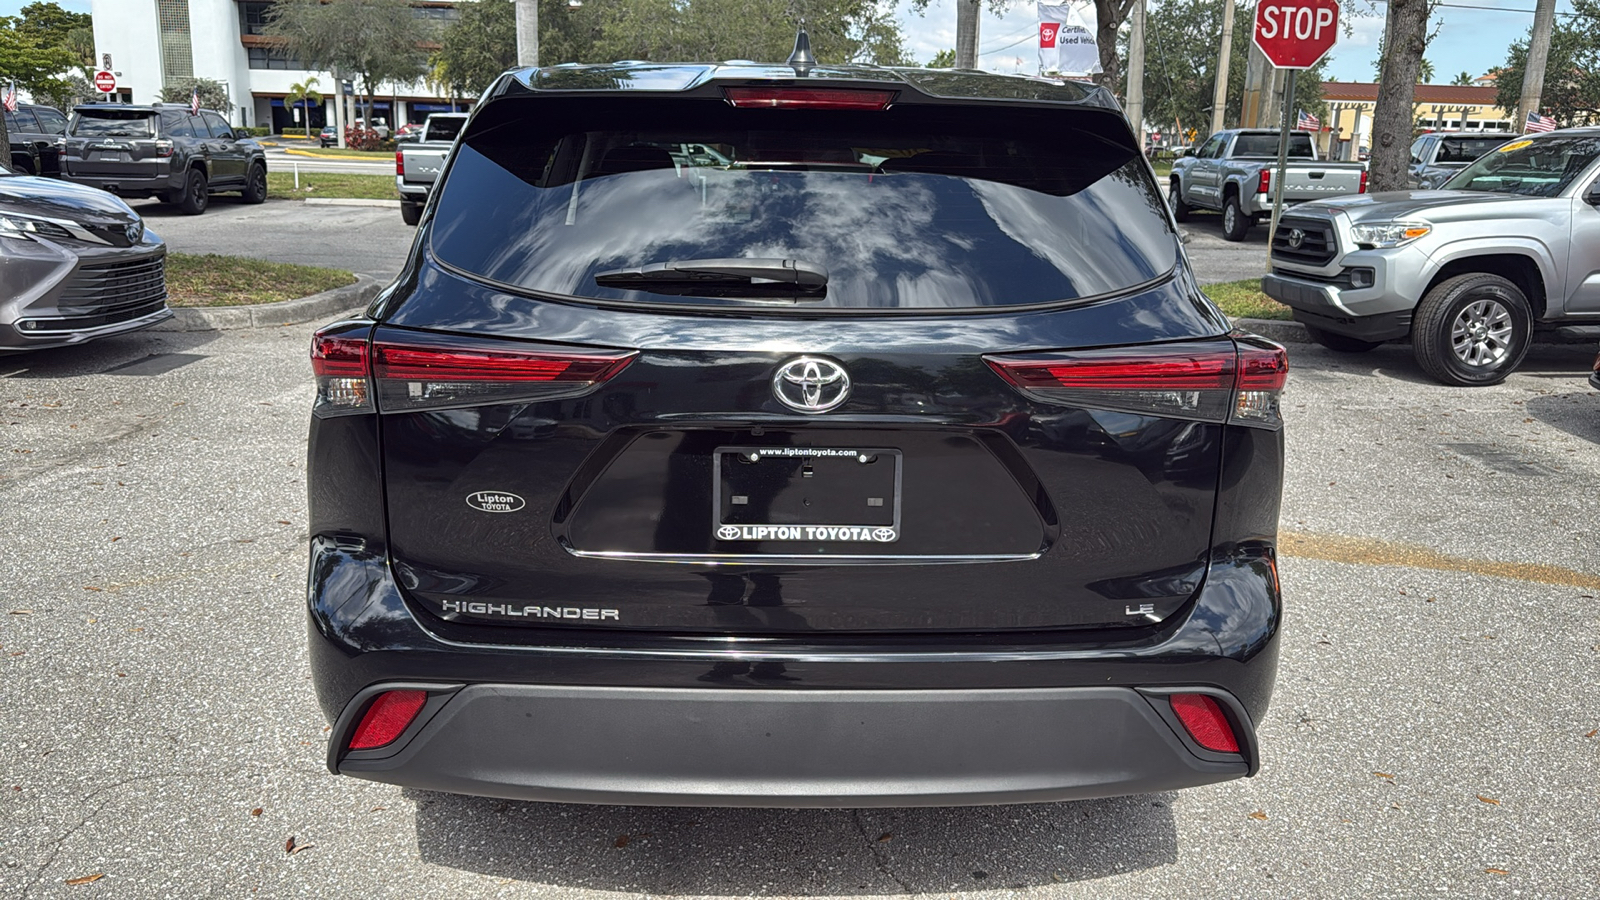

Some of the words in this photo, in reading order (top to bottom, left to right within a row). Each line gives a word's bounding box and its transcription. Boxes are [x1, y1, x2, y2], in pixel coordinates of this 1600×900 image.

[1261, 5, 1333, 40] STOP
[1060, 36, 1079, 45] Used
[759, 447, 857, 457] www.liptontoyota.com
[477, 493, 514, 504] Lipton
[481, 503, 511, 511] TOYOTA
[742, 526, 801, 540] LIPTON
[806, 527, 872, 541] TOYOTA
[442, 599, 620, 621] HIGHLANDER
[1125, 603, 1155, 616] LE
